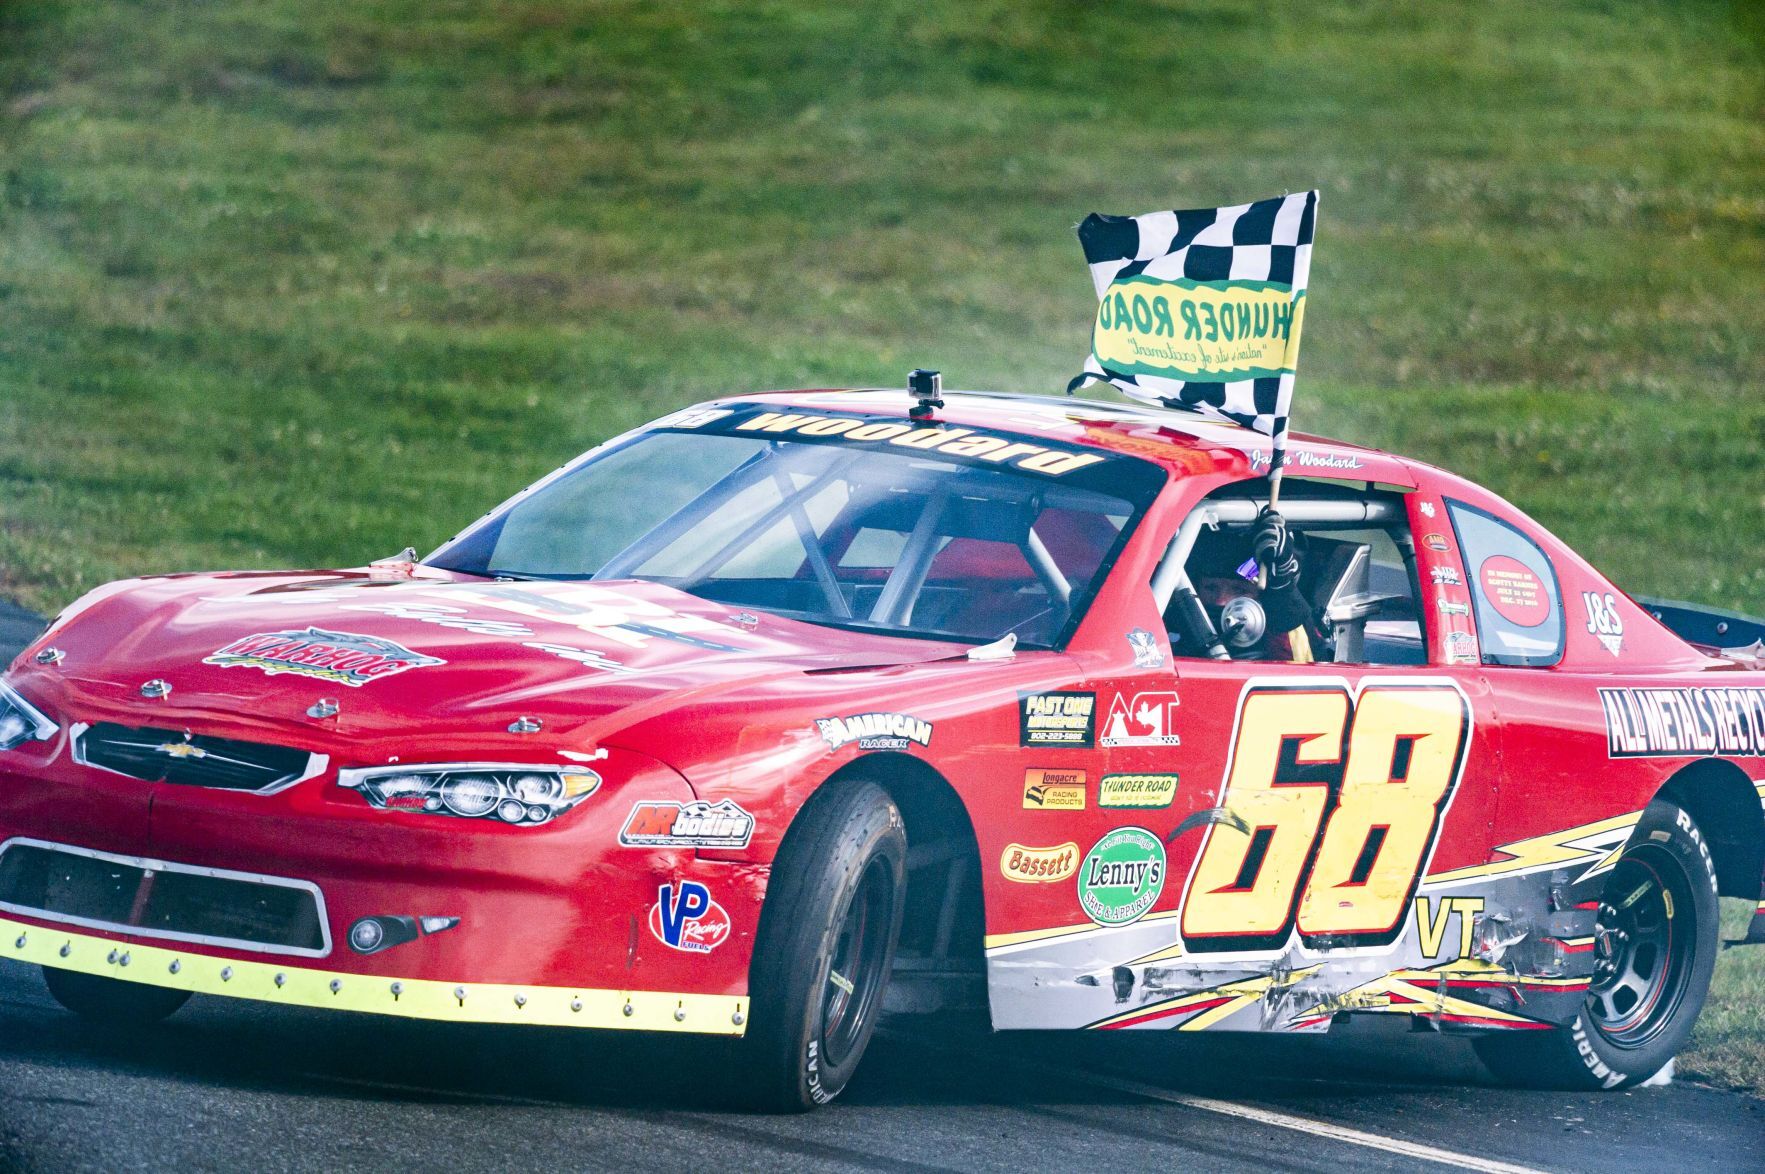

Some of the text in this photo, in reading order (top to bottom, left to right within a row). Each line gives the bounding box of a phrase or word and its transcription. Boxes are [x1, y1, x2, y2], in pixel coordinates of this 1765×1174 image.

[1252, 449, 1365, 470] Jan Woodard
[1581, 591, 1624, 637] J&S
[1026, 695, 1094, 716] FAST ONE
[1601, 688, 1765, 753] ALL METALS RECYC
[859, 738, 908, 750] RACER
[1042, 771, 1079, 785] Longacre
[1103, 780, 1172, 793] THUNDER ROAD
[1046, 798, 1083, 806] PRODUCTS
[1052, 791, 1078, 799] RACING
[1178, 677, 1473, 961] 68
[1008, 849, 1073, 877] Bassett
[1087, 855, 1161, 893] Lenny's
[659, 879, 710, 948] VP
[1112, 889, 1154, 919] APPAREL
[683, 919, 727, 941] Racing
[1415, 895, 1485, 960] VT
[1571, 1014, 1628, 1089] AMERIC
